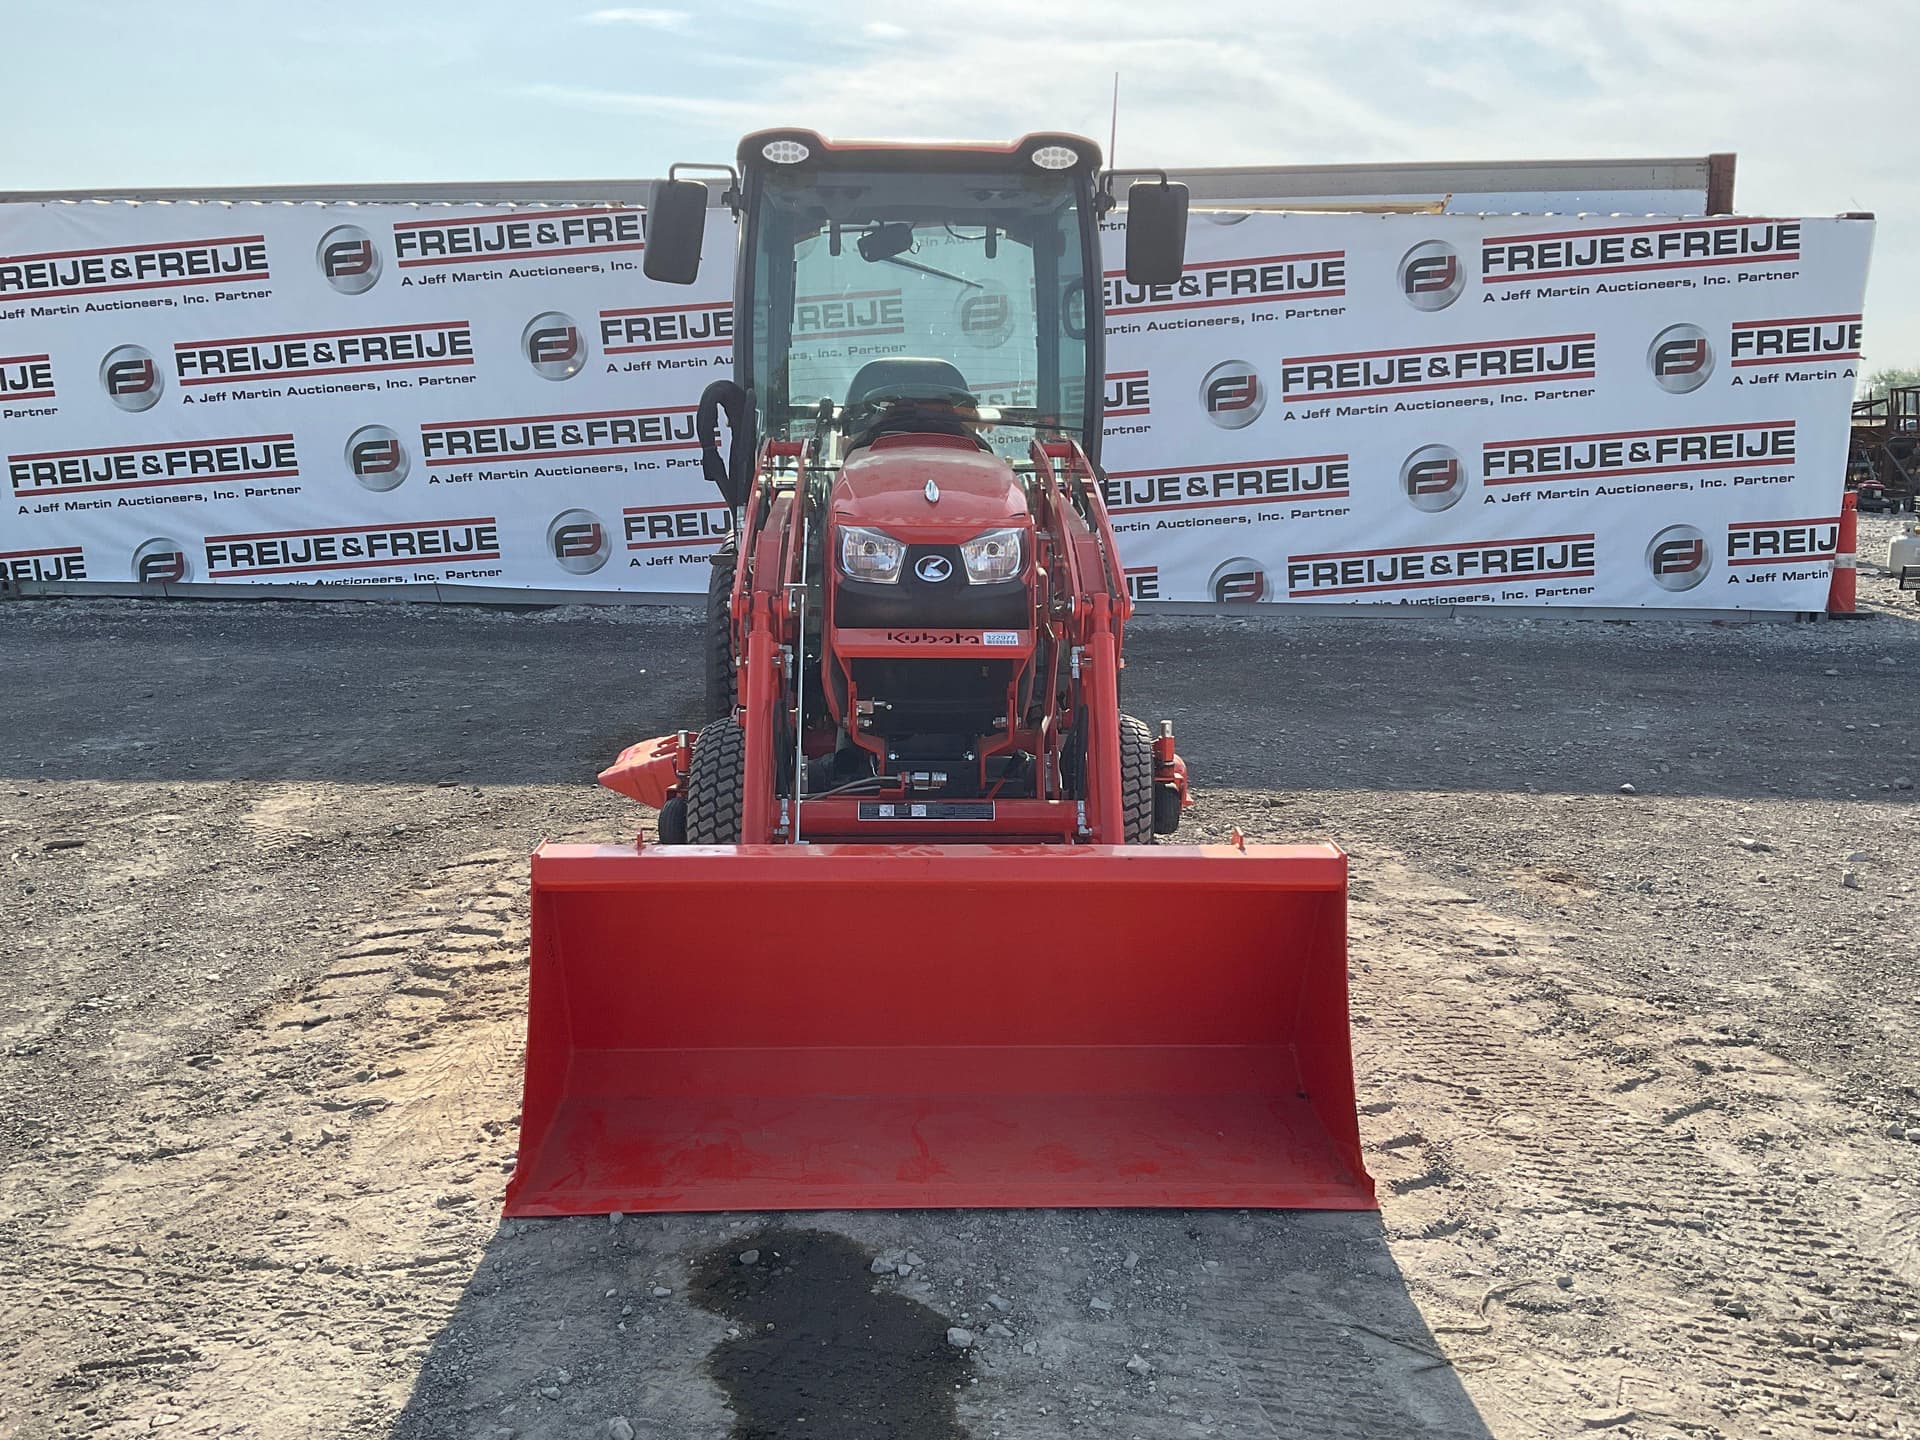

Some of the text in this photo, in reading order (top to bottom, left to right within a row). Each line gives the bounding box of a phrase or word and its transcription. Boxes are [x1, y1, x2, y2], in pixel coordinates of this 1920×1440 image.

[402, 277, 413, 286] A
[418, 274, 446, 284] Jeff
[452, 271, 502, 282] Martin
[611, 262, 637, 270] Inc.
[1483, 293, 1495, 302] A
[1502, 290, 1530, 300] Jeff
[1538, 286, 1589, 298] Martin
[1704, 276, 1730, 285] Inc.
[1738, 272, 1799, 282] Partner
[31, 305, 79, 316] Martin
[184, 295, 208, 304] Inc.
[215, 291, 272, 301] Partner
[1105, 322, 1140, 335] artin
[1252, 313, 1278, 322] Inc.
[1286, 308, 1346, 319] Partner
[848, 345, 906, 356] Partner
[607, 364, 618, 372] A
[624, 361, 651, 371] Jeff
[657, 358, 707, 369] Martin
[1732, 376, 1743, 385] A
[1750, 374, 1779, 384] Jeff
[1786, 370, 1836, 382] Martin
[184, 395, 194, 404] A
[200, 392, 226, 402] Jeff
[232, 389, 281, 400] Martin
[387, 380, 412, 388] Inc.
[419, 376, 476, 386] Partner
[1284, 412, 1296, 420] A
[1302, 408, 1330, 419] Jeff
[1337, 404, 1388, 416] Martin
[1501, 394, 1527, 403] Inc.
[1535, 390, 1595, 400] Partner
[4, 408, 58, 418] Partner
[1104, 426, 1150, 435] artner
[429, 476, 440, 484] A
[446, 473, 472, 482] Jeff
[479, 470, 528, 480] Martin
[634, 462, 660, 470] Inc.
[1484, 495, 1496, 504] A
[1502, 492, 1531, 502] Jeff
[1538, 488, 1588, 500] Martin
[1701, 479, 1726, 488] Inc.
[1734, 476, 1794, 485] Partner
[18, 506, 29, 514] A
[34, 503, 59, 513] Jeff
[65, 500, 111, 510] Martin
[214, 491, 238, 499] Inc.
[245, 487, 301, 497] Partner
[1258, 513, 1284, 521] Inc.
[1291, 508, 1350, 518] Partner
[630, 558, 640, 567] A
[646, 556, 673, 566] Jeff
[414, 572, 440, 581] Inc.
[446, 568, 502, 579] Partner
[1728, 570, 1829, 584] A Jeff Martin
[1502, 591, 1528, 600] Inc.
[1536, 587, 1594, 597] Partner
[887, 632, 979, 644] Kubota
